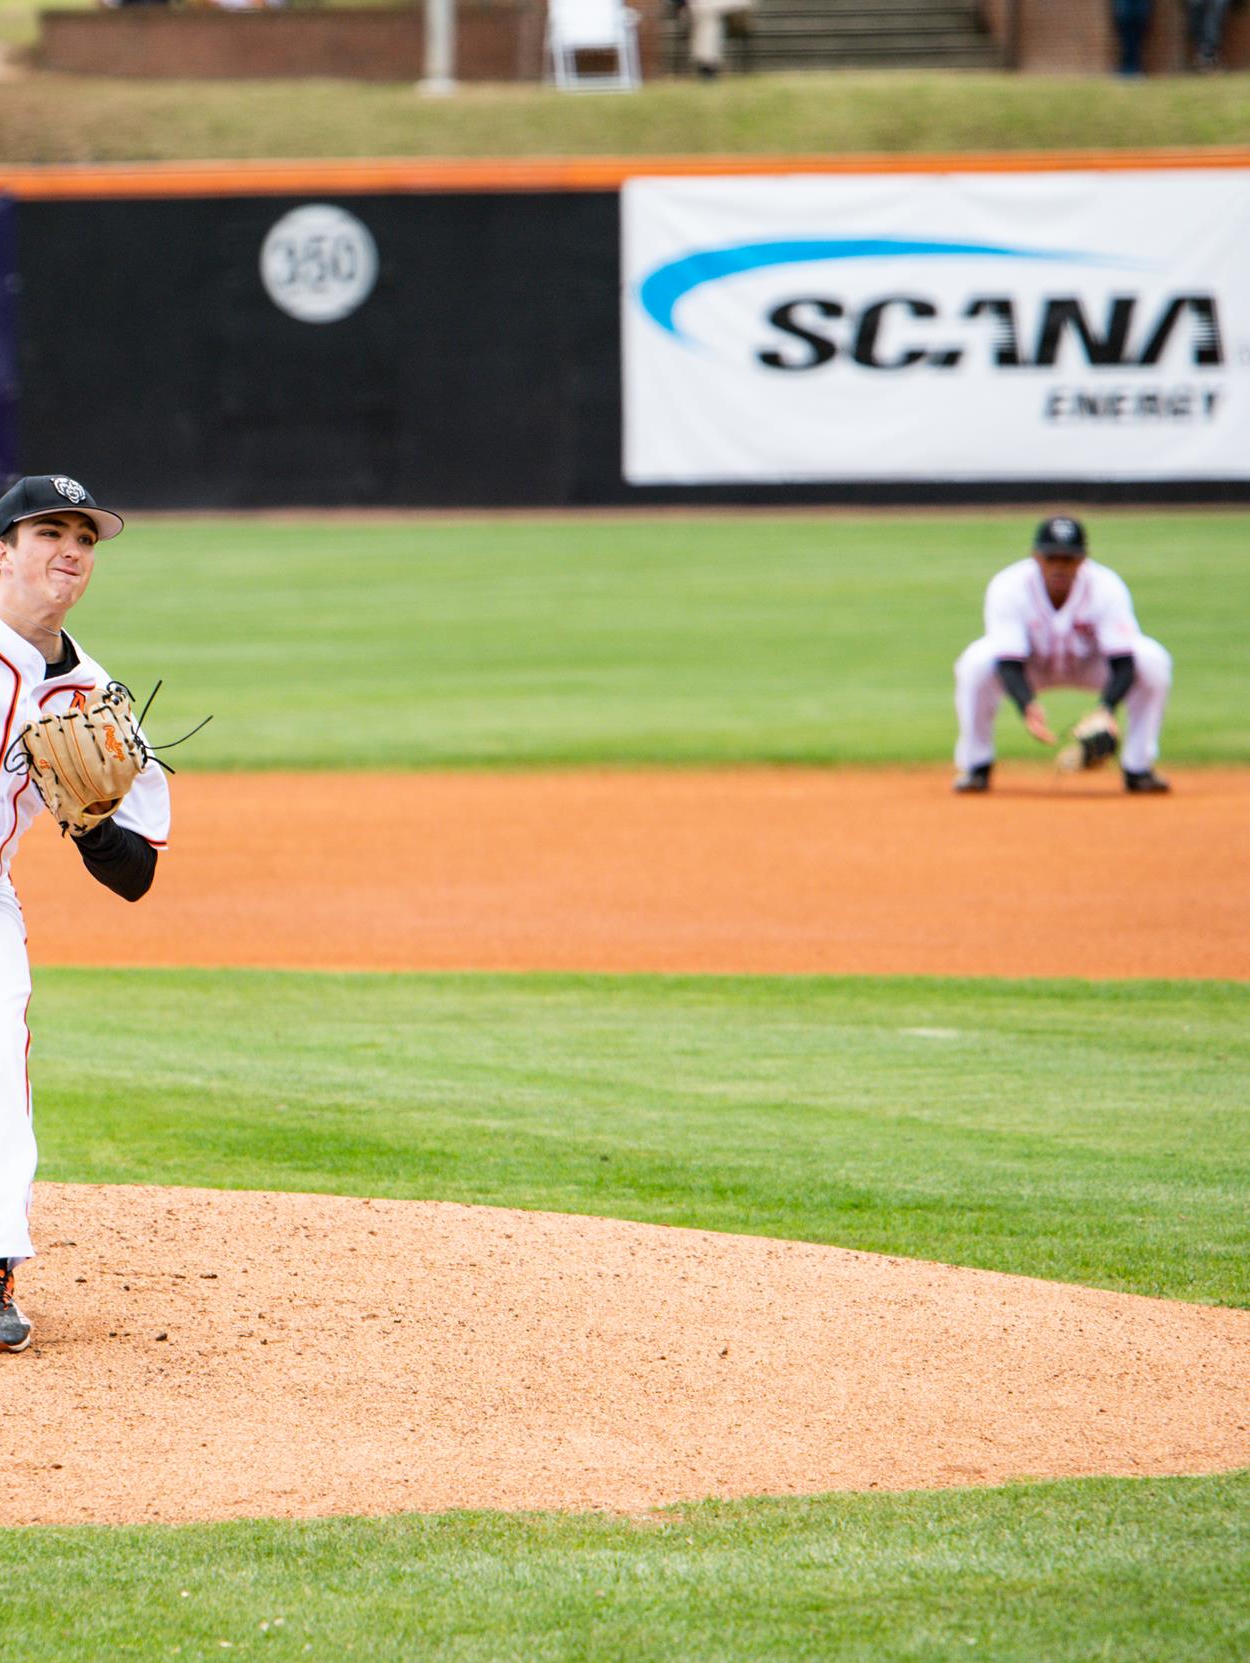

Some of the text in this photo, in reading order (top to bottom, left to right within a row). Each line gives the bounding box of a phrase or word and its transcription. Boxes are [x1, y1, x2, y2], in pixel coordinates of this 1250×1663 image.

[272, 233, 359, 289] 350
[756, 296, 1222, 370] SCANA
[1045, 388, 1218, 424] ENERGY
